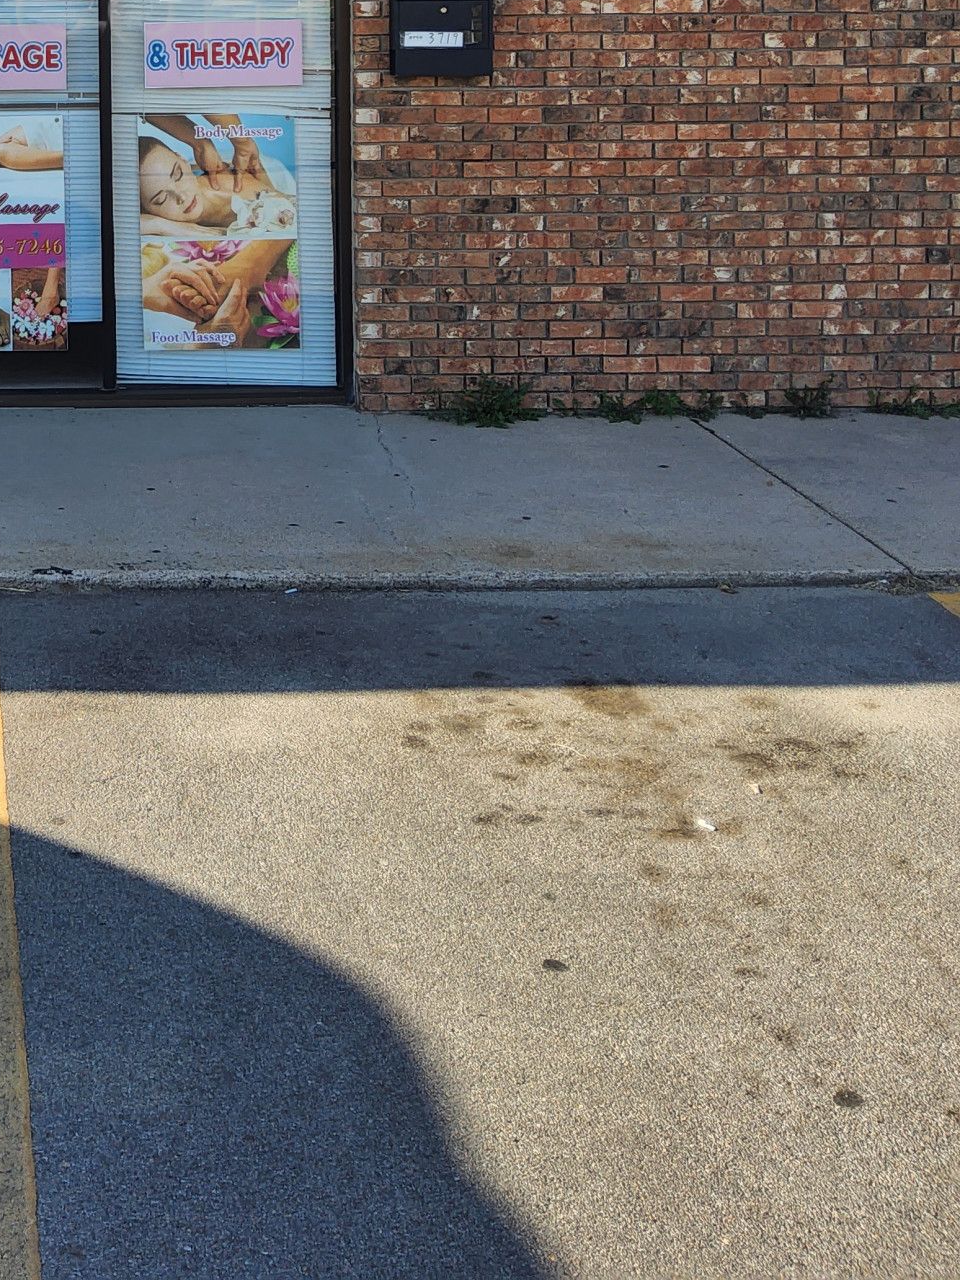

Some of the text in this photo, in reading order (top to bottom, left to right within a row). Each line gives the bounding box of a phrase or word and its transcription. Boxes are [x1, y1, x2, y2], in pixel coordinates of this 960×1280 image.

[429, 32, 458, 45] 3719
[147, 38, 295, 70] & THERAPY
[194, 124, 283, 140] Body Massage
[151, 330, 237, 346] Foot Massage
